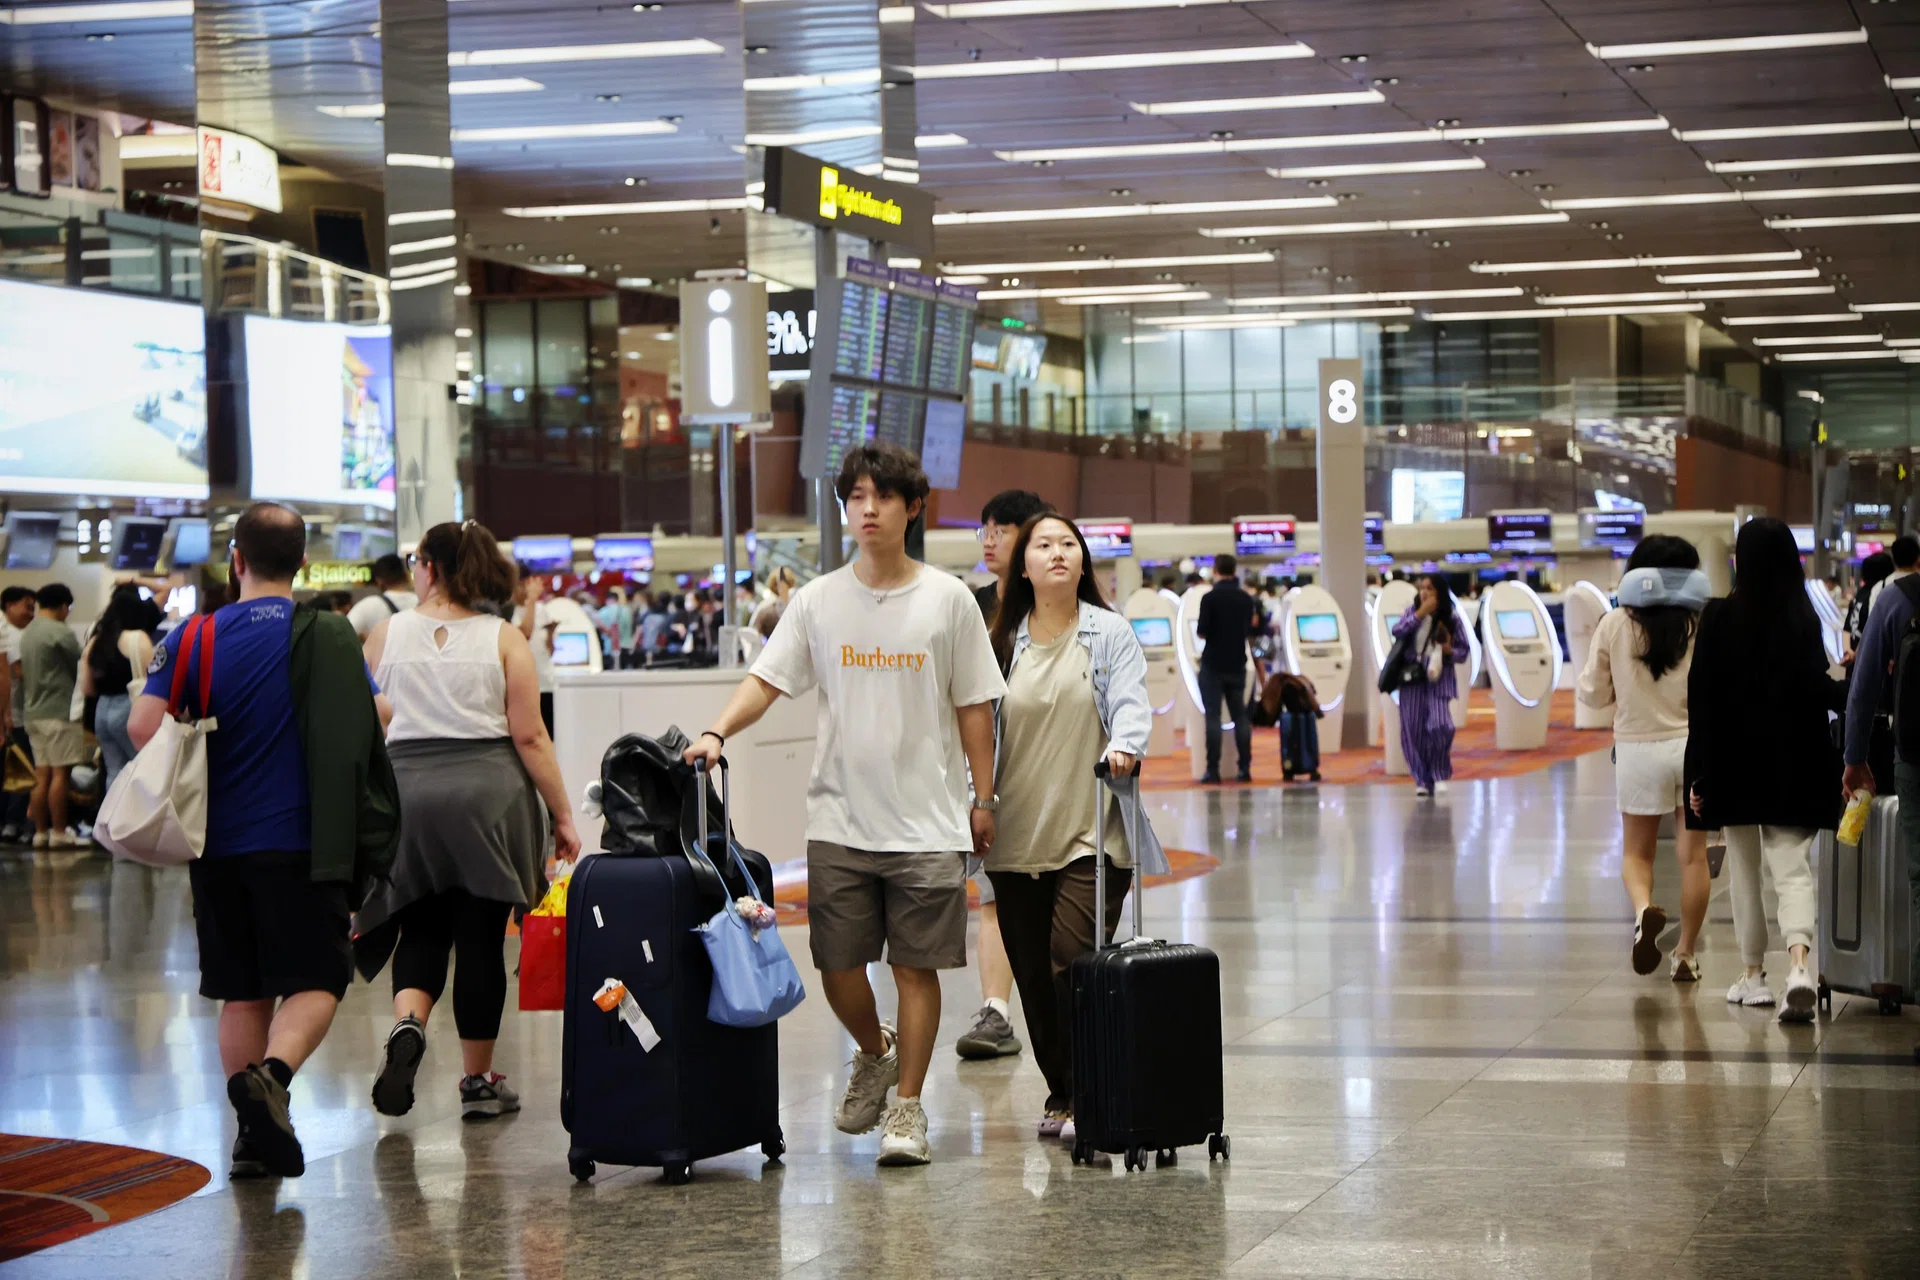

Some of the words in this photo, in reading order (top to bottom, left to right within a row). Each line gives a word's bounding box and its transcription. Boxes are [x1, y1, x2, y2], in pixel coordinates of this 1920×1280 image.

[1328, 379, 1357, 423] 8
[309, 563, 372, 583] Station
[841, 644, 927, 672] Burberry
